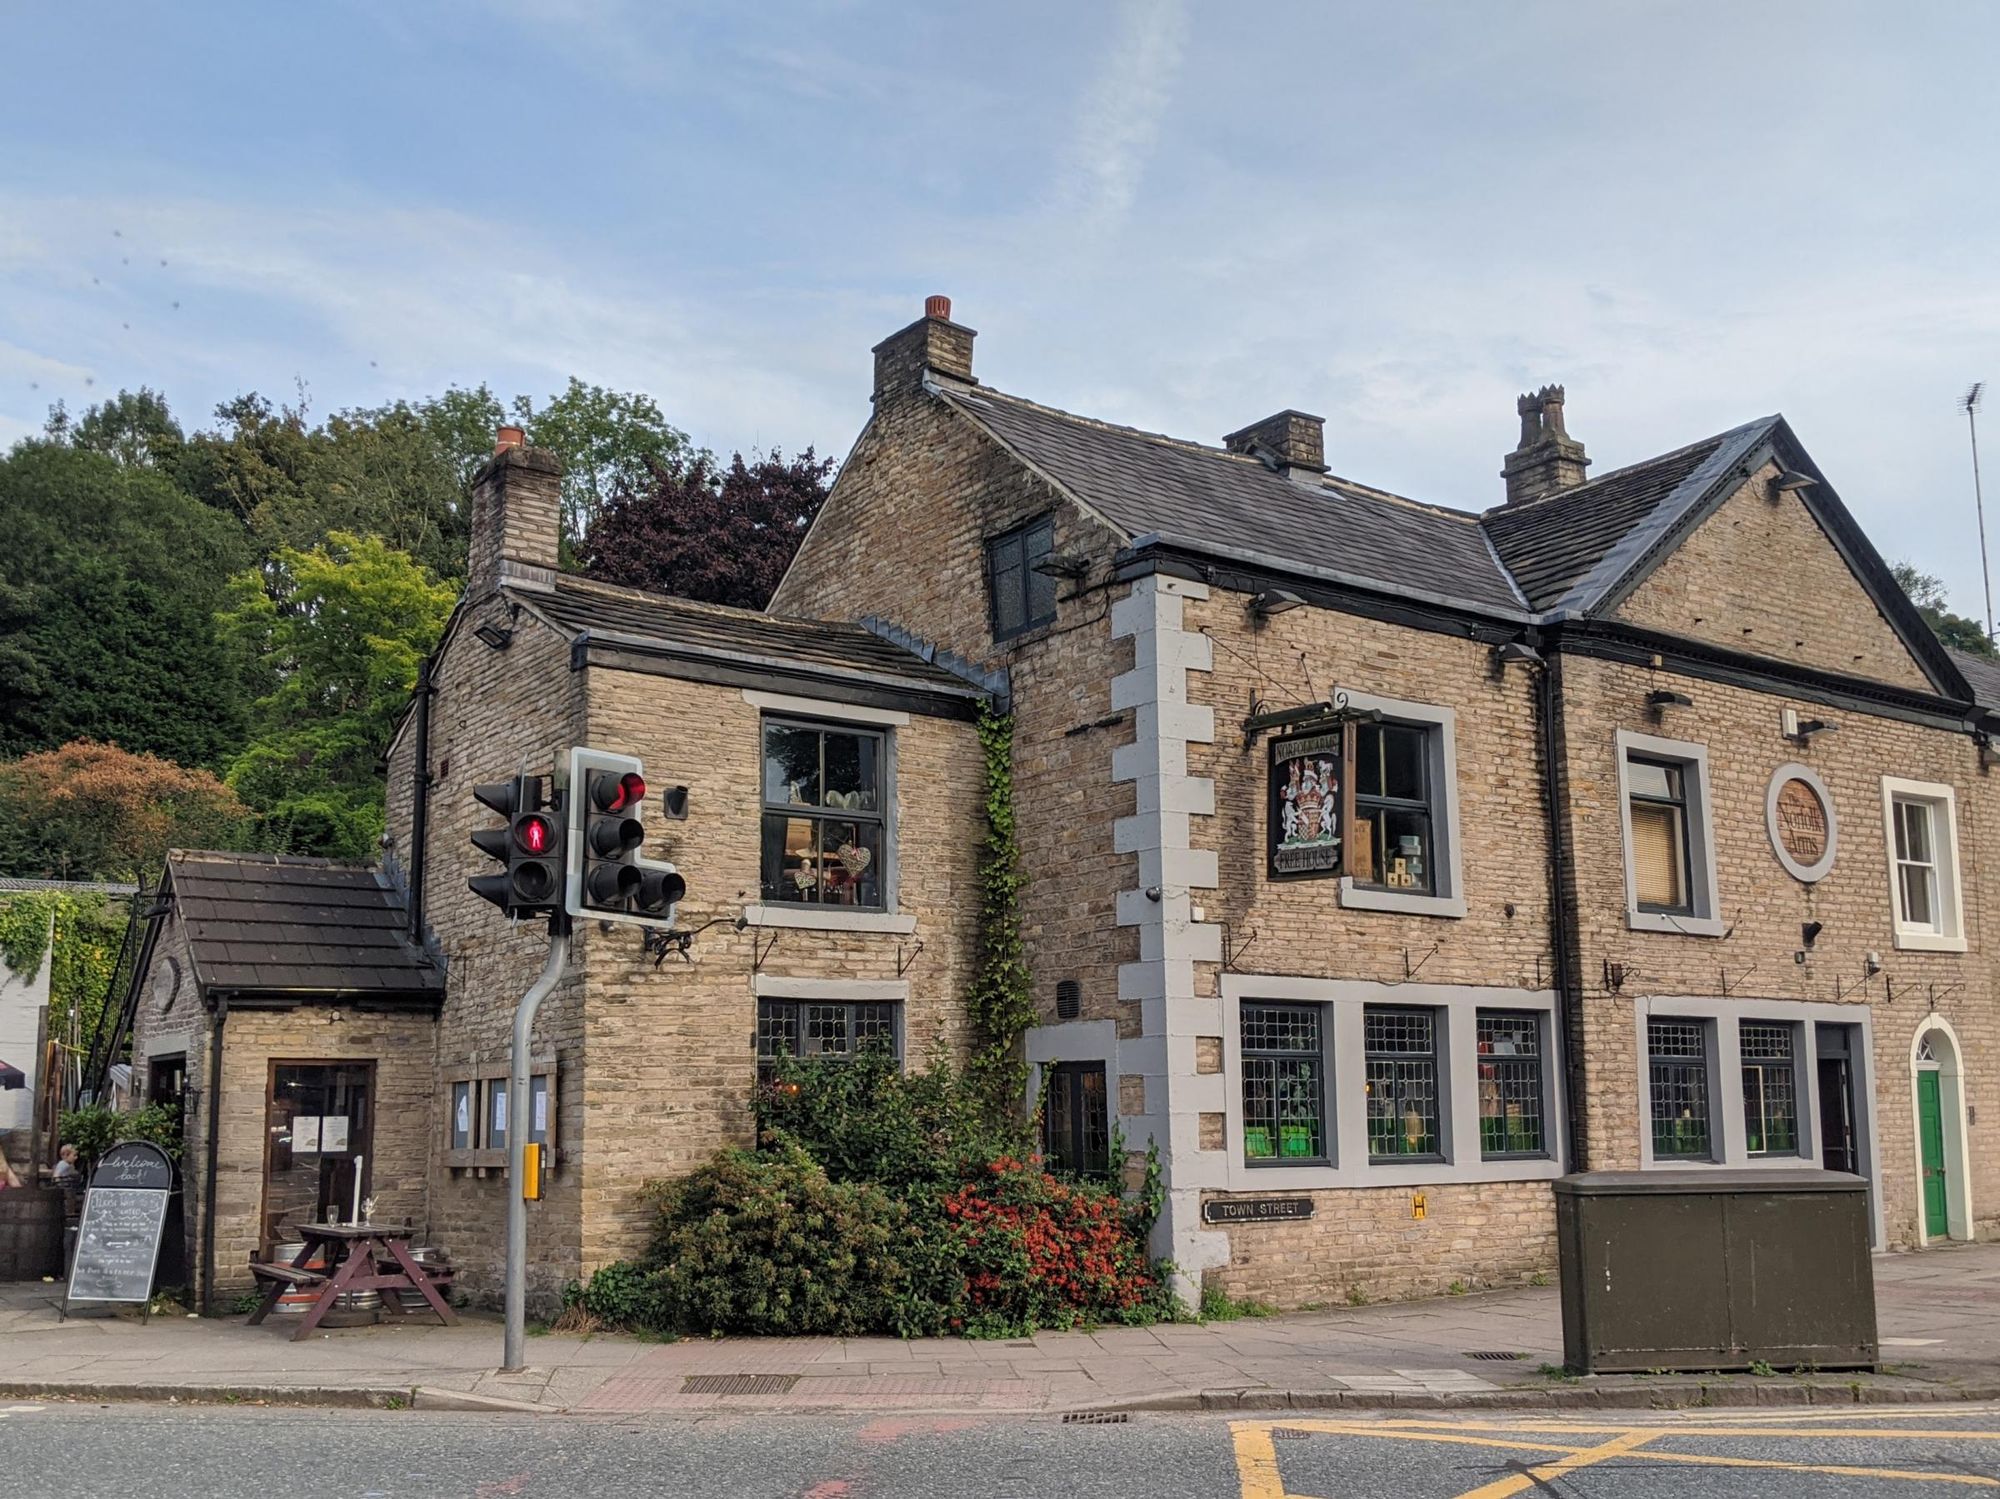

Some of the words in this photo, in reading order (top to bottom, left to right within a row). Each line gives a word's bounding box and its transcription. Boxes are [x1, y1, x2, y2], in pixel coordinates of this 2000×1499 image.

[1280, 851, 1300, 869] FREE
[1303, 848, 1332, 868] HOUSE
[1222, 1204, 1254, 1217] TOWN
[1260, 1202, 1299, 1215] STREET
[1412, 1195, 1426, 1218] H
